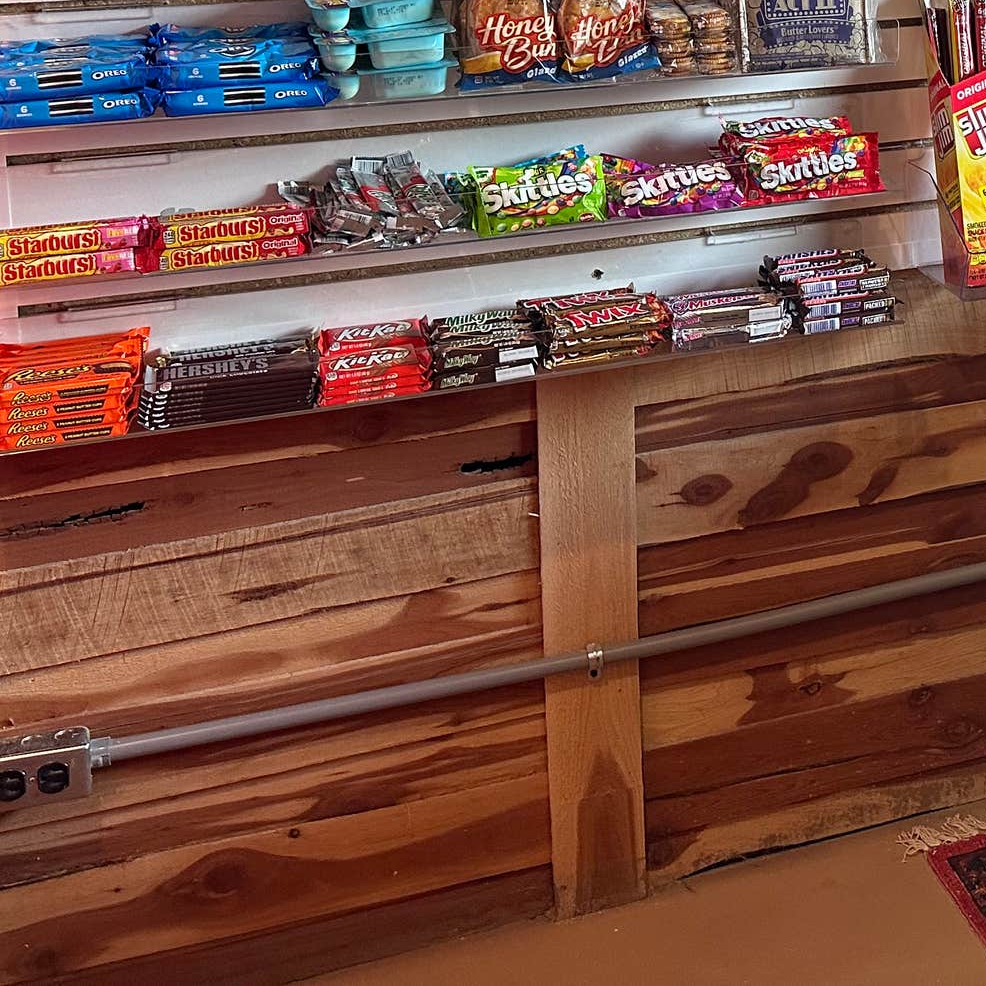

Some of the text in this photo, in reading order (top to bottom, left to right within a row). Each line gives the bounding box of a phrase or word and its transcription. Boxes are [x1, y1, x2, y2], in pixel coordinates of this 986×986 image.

[477, 14, 556, 45] Honey
[780, 25, 835, 37] Butter Lovers
[502, 36, 556, 69] Bun
[91, 69, 127, 80] OREO
[269, 62, 302, 73] OREO
[102, 98, 138, 109] OREO
[274, 90, 308, 99] OREO
[739, 117, 836, 138] Skittles
[760, 152, 858, 190] Skittles
[482, 170, 593, 214] Skittles
[621, 162, 732, 206] Skittles
[179, 217, 265, 242] Starburst
[9, 230, 100, 257] Starburst
[173, 238, 298, 268] Starburst Original
[4, 255, 96, 282] Starburst
[562, 303, 650, 333] TWIX
[164, 357, 269, 380] HERSHEY'S
[11, 391, 52, 405] Reese's
[7, 407, 48, 420] Reese's
[7, 421, 48, 434] Reese's
[16, 434, 56, 447] Reese's
